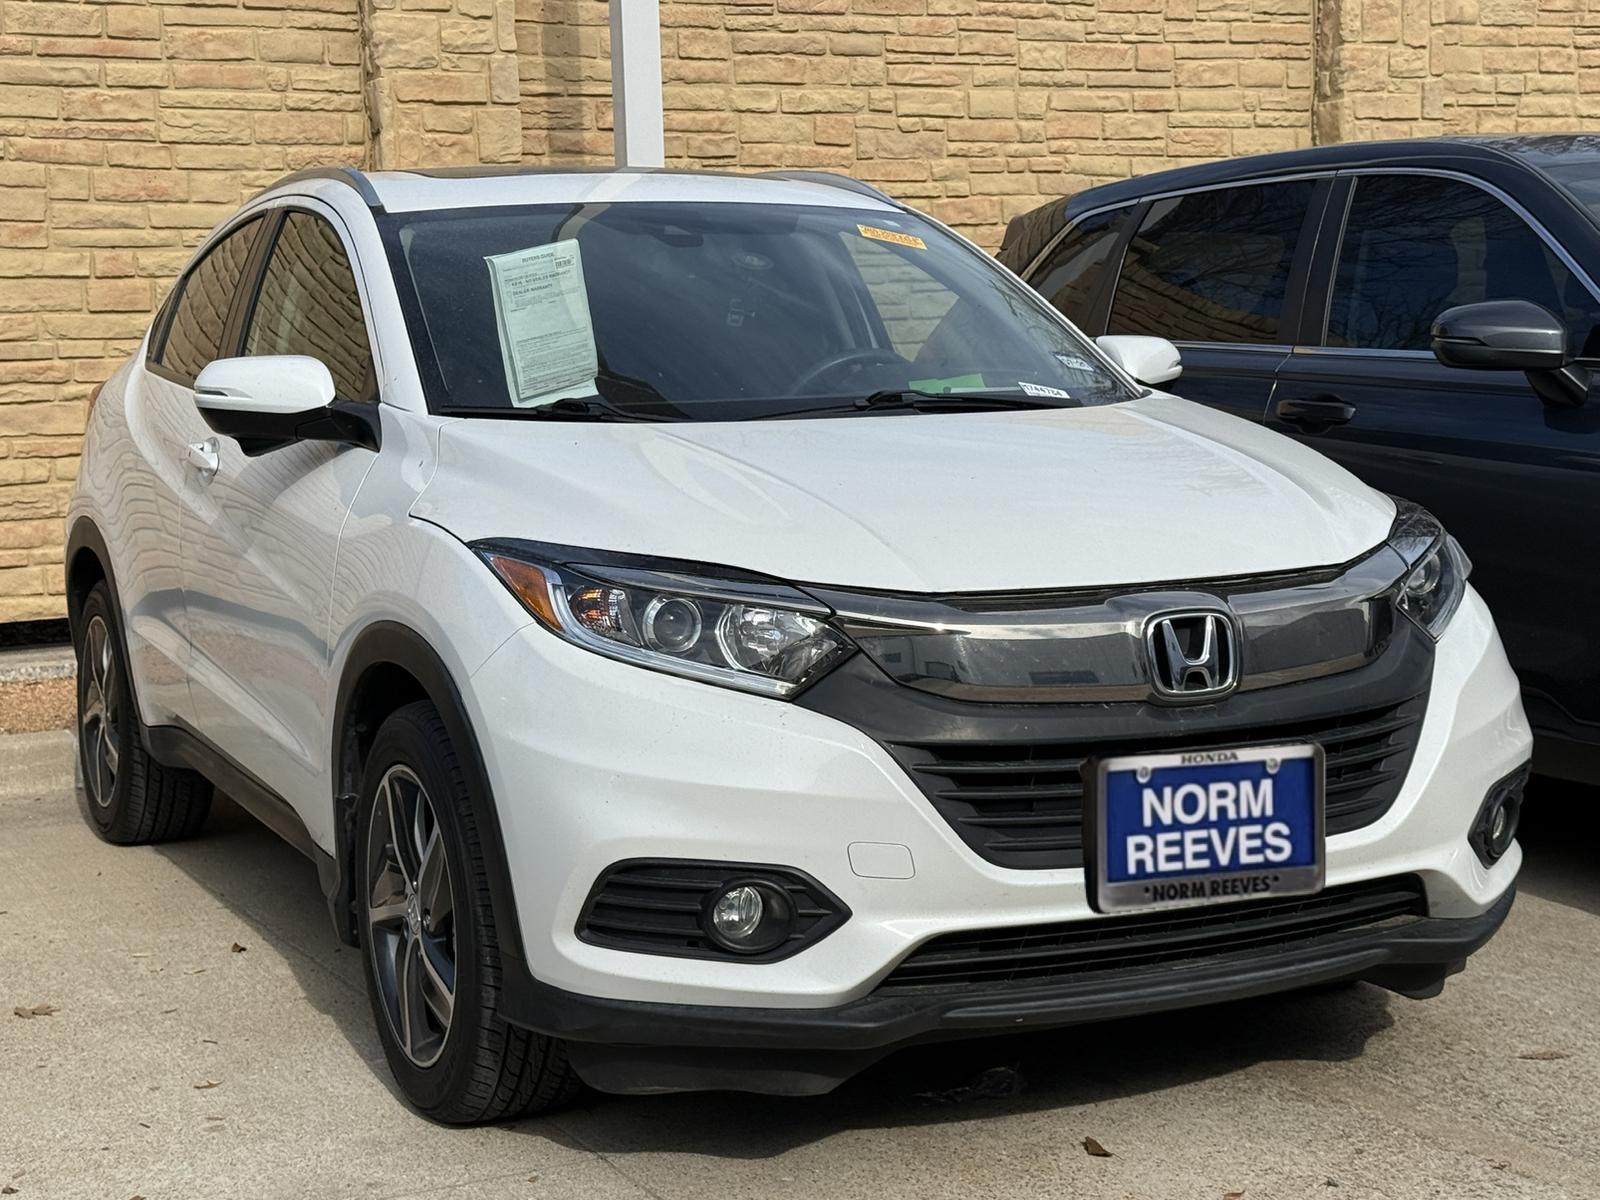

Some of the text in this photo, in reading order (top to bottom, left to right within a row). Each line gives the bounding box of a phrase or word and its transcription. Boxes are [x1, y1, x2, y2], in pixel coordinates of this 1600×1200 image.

[1181, 751, 1239, 765] HONDA
[1142, 777, 1274, 828] NORM
[1125, 822, 1293, 875] REEVES
[1154, 875, 1271, 901] NORM REEVES
